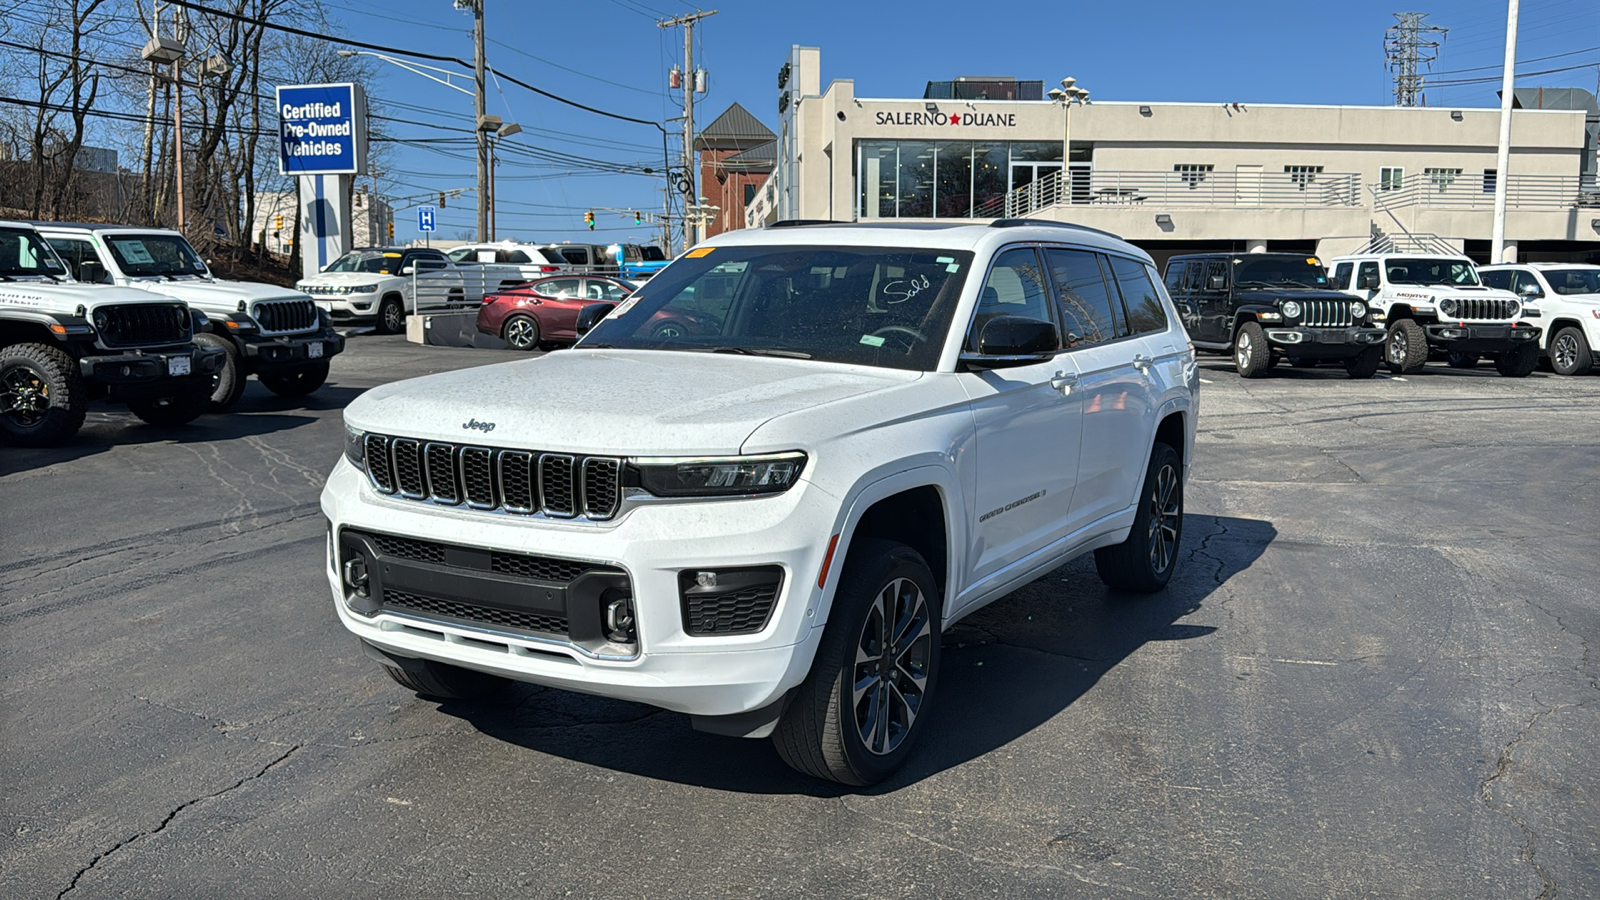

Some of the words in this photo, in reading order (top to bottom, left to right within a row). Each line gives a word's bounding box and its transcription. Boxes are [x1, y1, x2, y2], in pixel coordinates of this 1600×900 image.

[282, 101, 341, 120] Certified
[875, 111, 948, 126] SALERNO
[962, 112, 1016, 127] DUANE
[283, 120, 351, 138] Pre-Owned
[284, 140, 342, 157] Vehicles
[421, 211, 432, 225] H
[462, 418, 496, 434] Jeep
